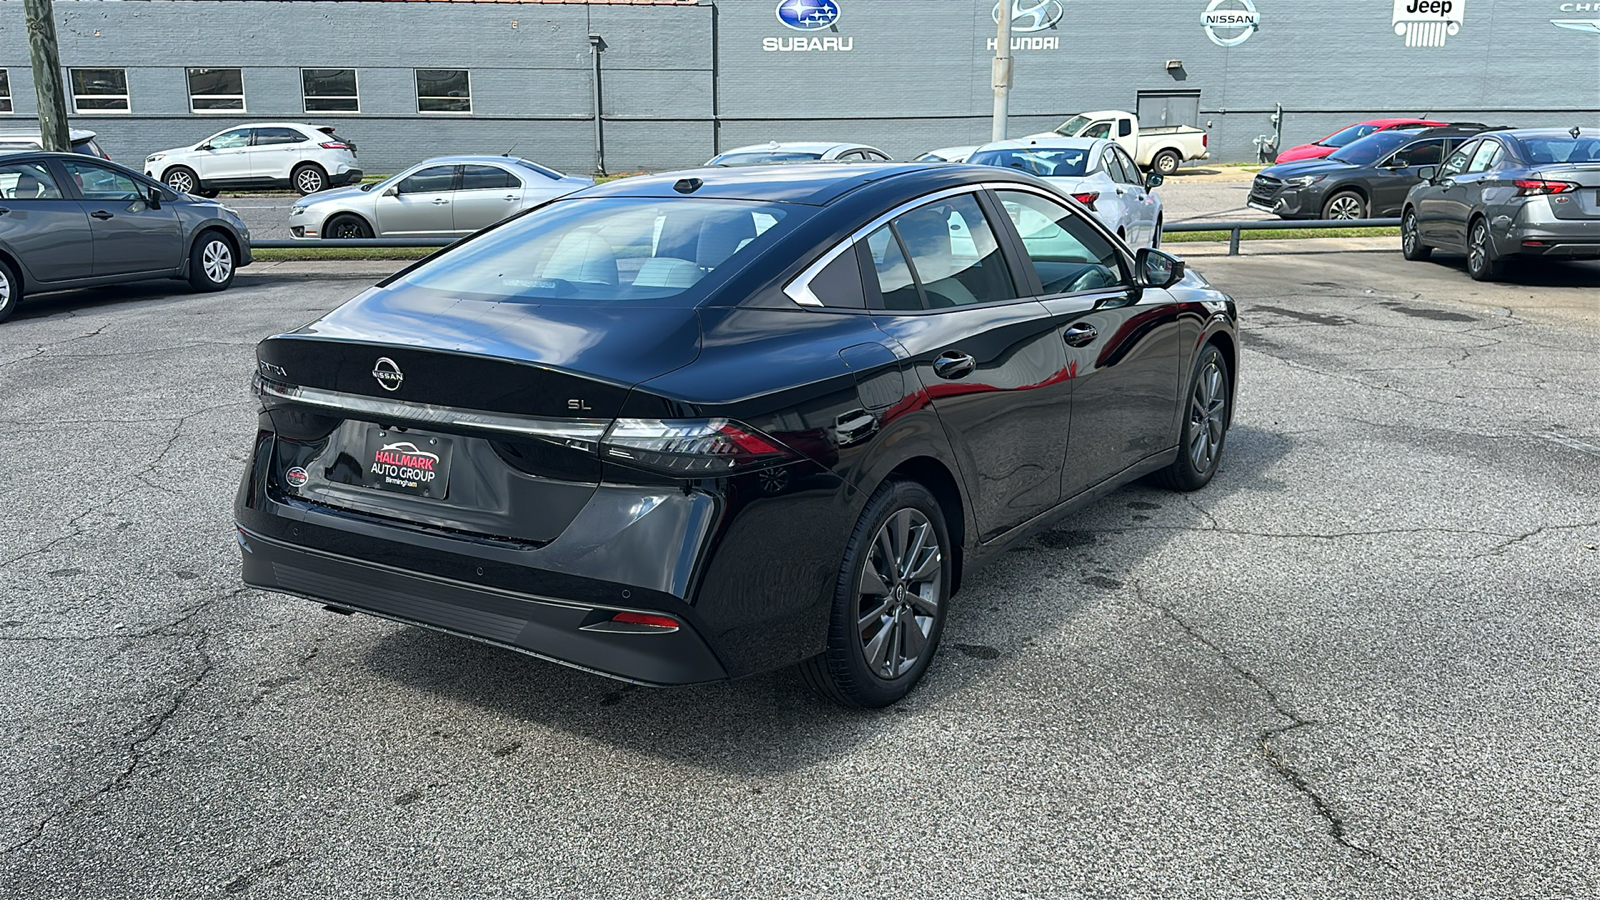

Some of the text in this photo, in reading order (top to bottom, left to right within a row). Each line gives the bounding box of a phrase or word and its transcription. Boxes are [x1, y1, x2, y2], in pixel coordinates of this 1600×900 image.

[1406, 0, 1452, 17] Jeep
[1206, 15, 1254, 23] NISSAN
[762, 37, 853, 51] SUBARU
[987, 37, 1059, 50] HUNDAI
[372, 370, 403, 380] NISSAN
[568, 399, 592, 410] SL
[375, 451, 434, 470] HALLMARK
[370, 462, 435, 482] AUTO GROUP
[385, 476, 418, 488] Birmingham
